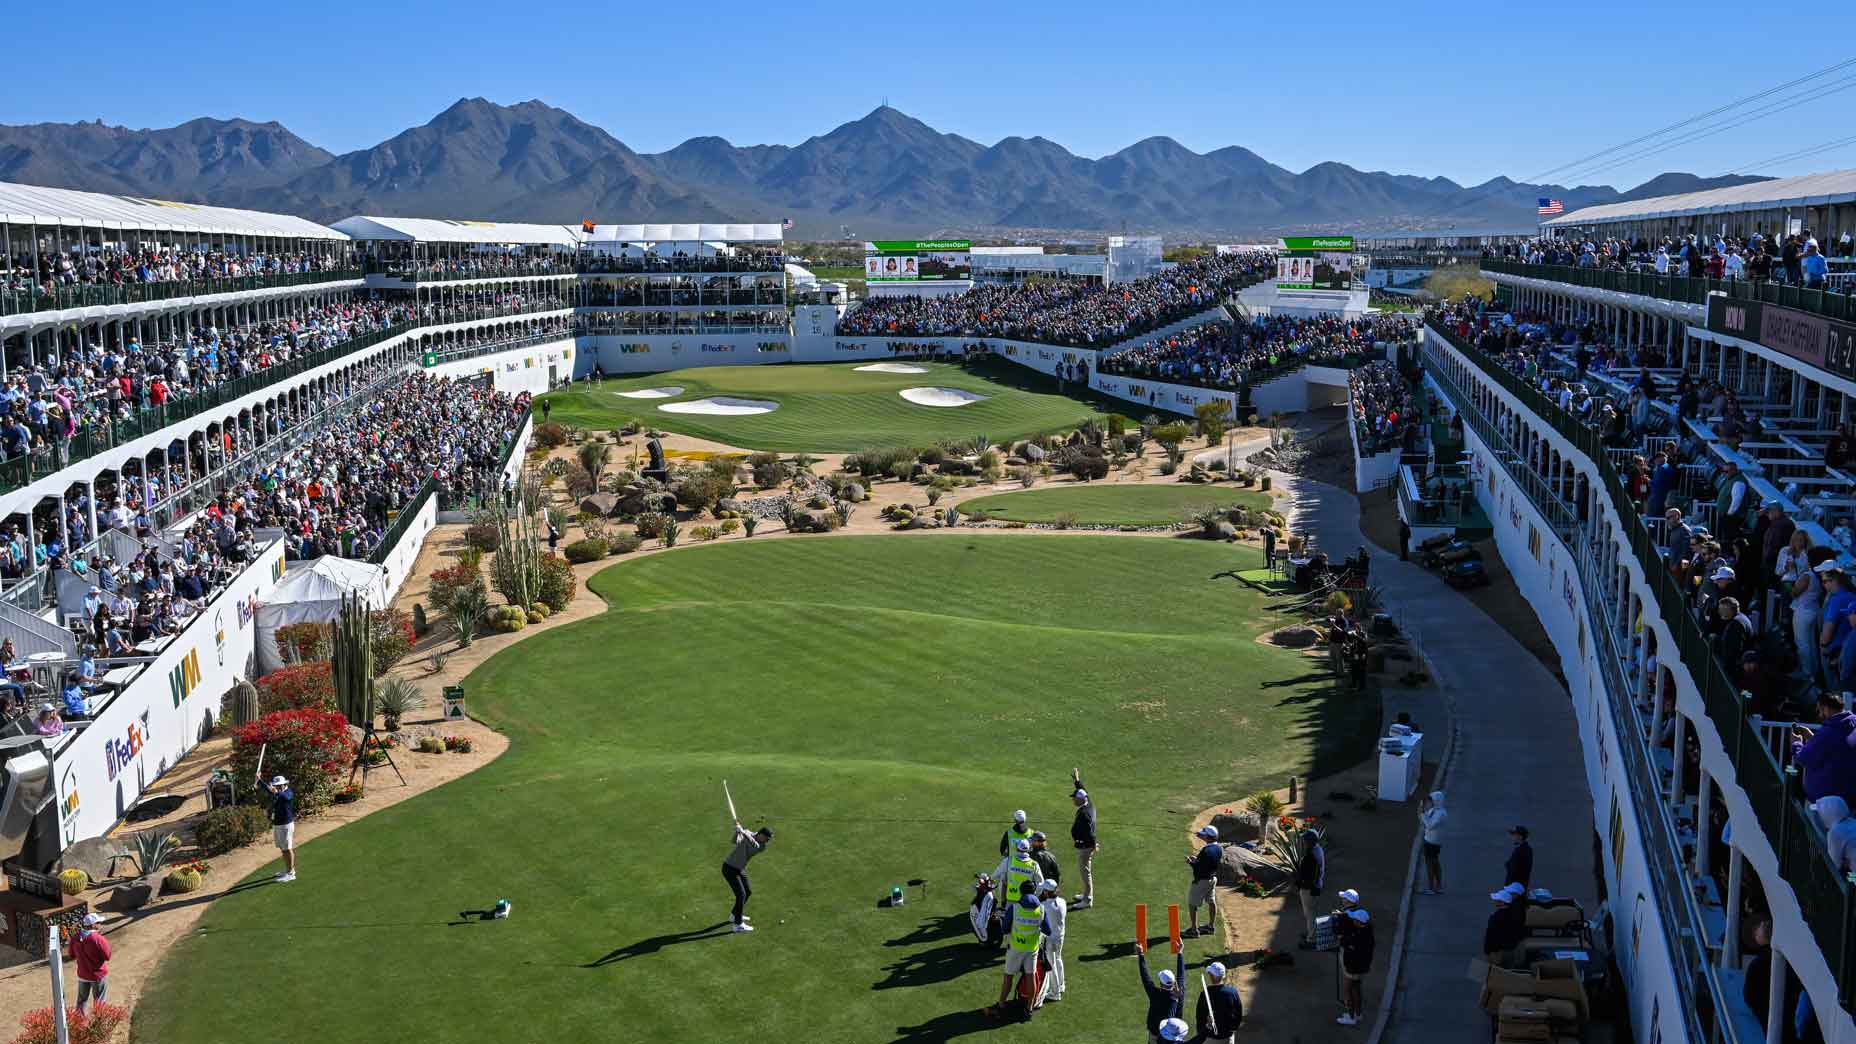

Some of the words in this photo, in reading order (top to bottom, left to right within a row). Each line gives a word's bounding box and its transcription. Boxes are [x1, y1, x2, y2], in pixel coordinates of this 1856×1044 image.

[915, 241, 969, 249] #ThePeoplesOpen
[168, 647, 202, 710] WM
[114, 723, 143, 773] FedEx
[61, 790, 80, 820] WM
